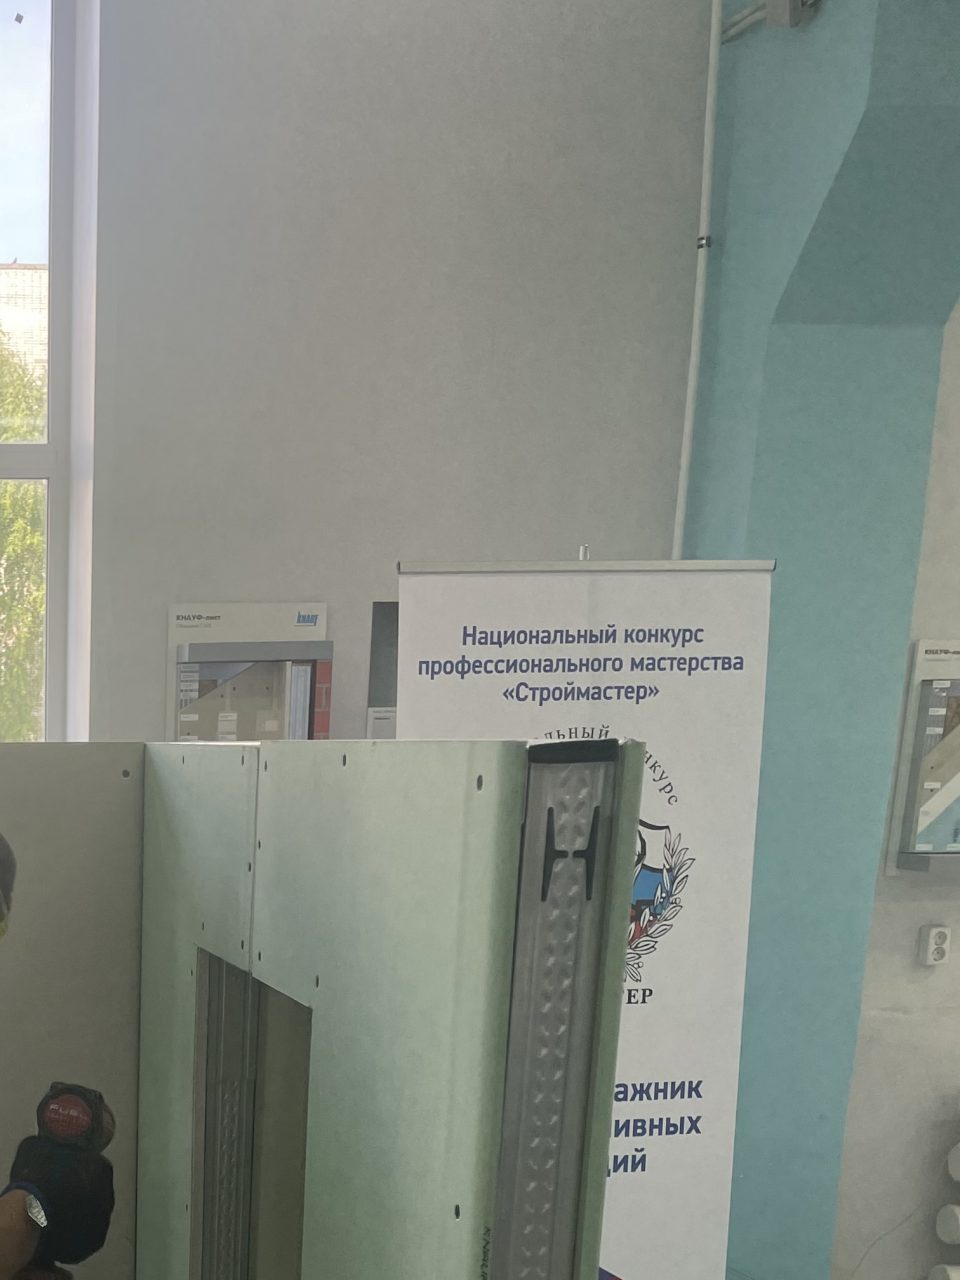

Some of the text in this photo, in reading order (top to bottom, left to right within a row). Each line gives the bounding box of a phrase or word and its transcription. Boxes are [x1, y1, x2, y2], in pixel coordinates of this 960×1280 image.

[462, 624, 704, 648] Национальный конкурс
[418, 655, 744, 680] профессионального мастерства
[502, 681, 660, 706] «Строймастер»
[624, 988, 653, 1005] ЕР
[613, 1080, 703, 1102] ажник
[613, 1116, 703, 1138] ивных
[607, 1148, 647, 1178] ий
